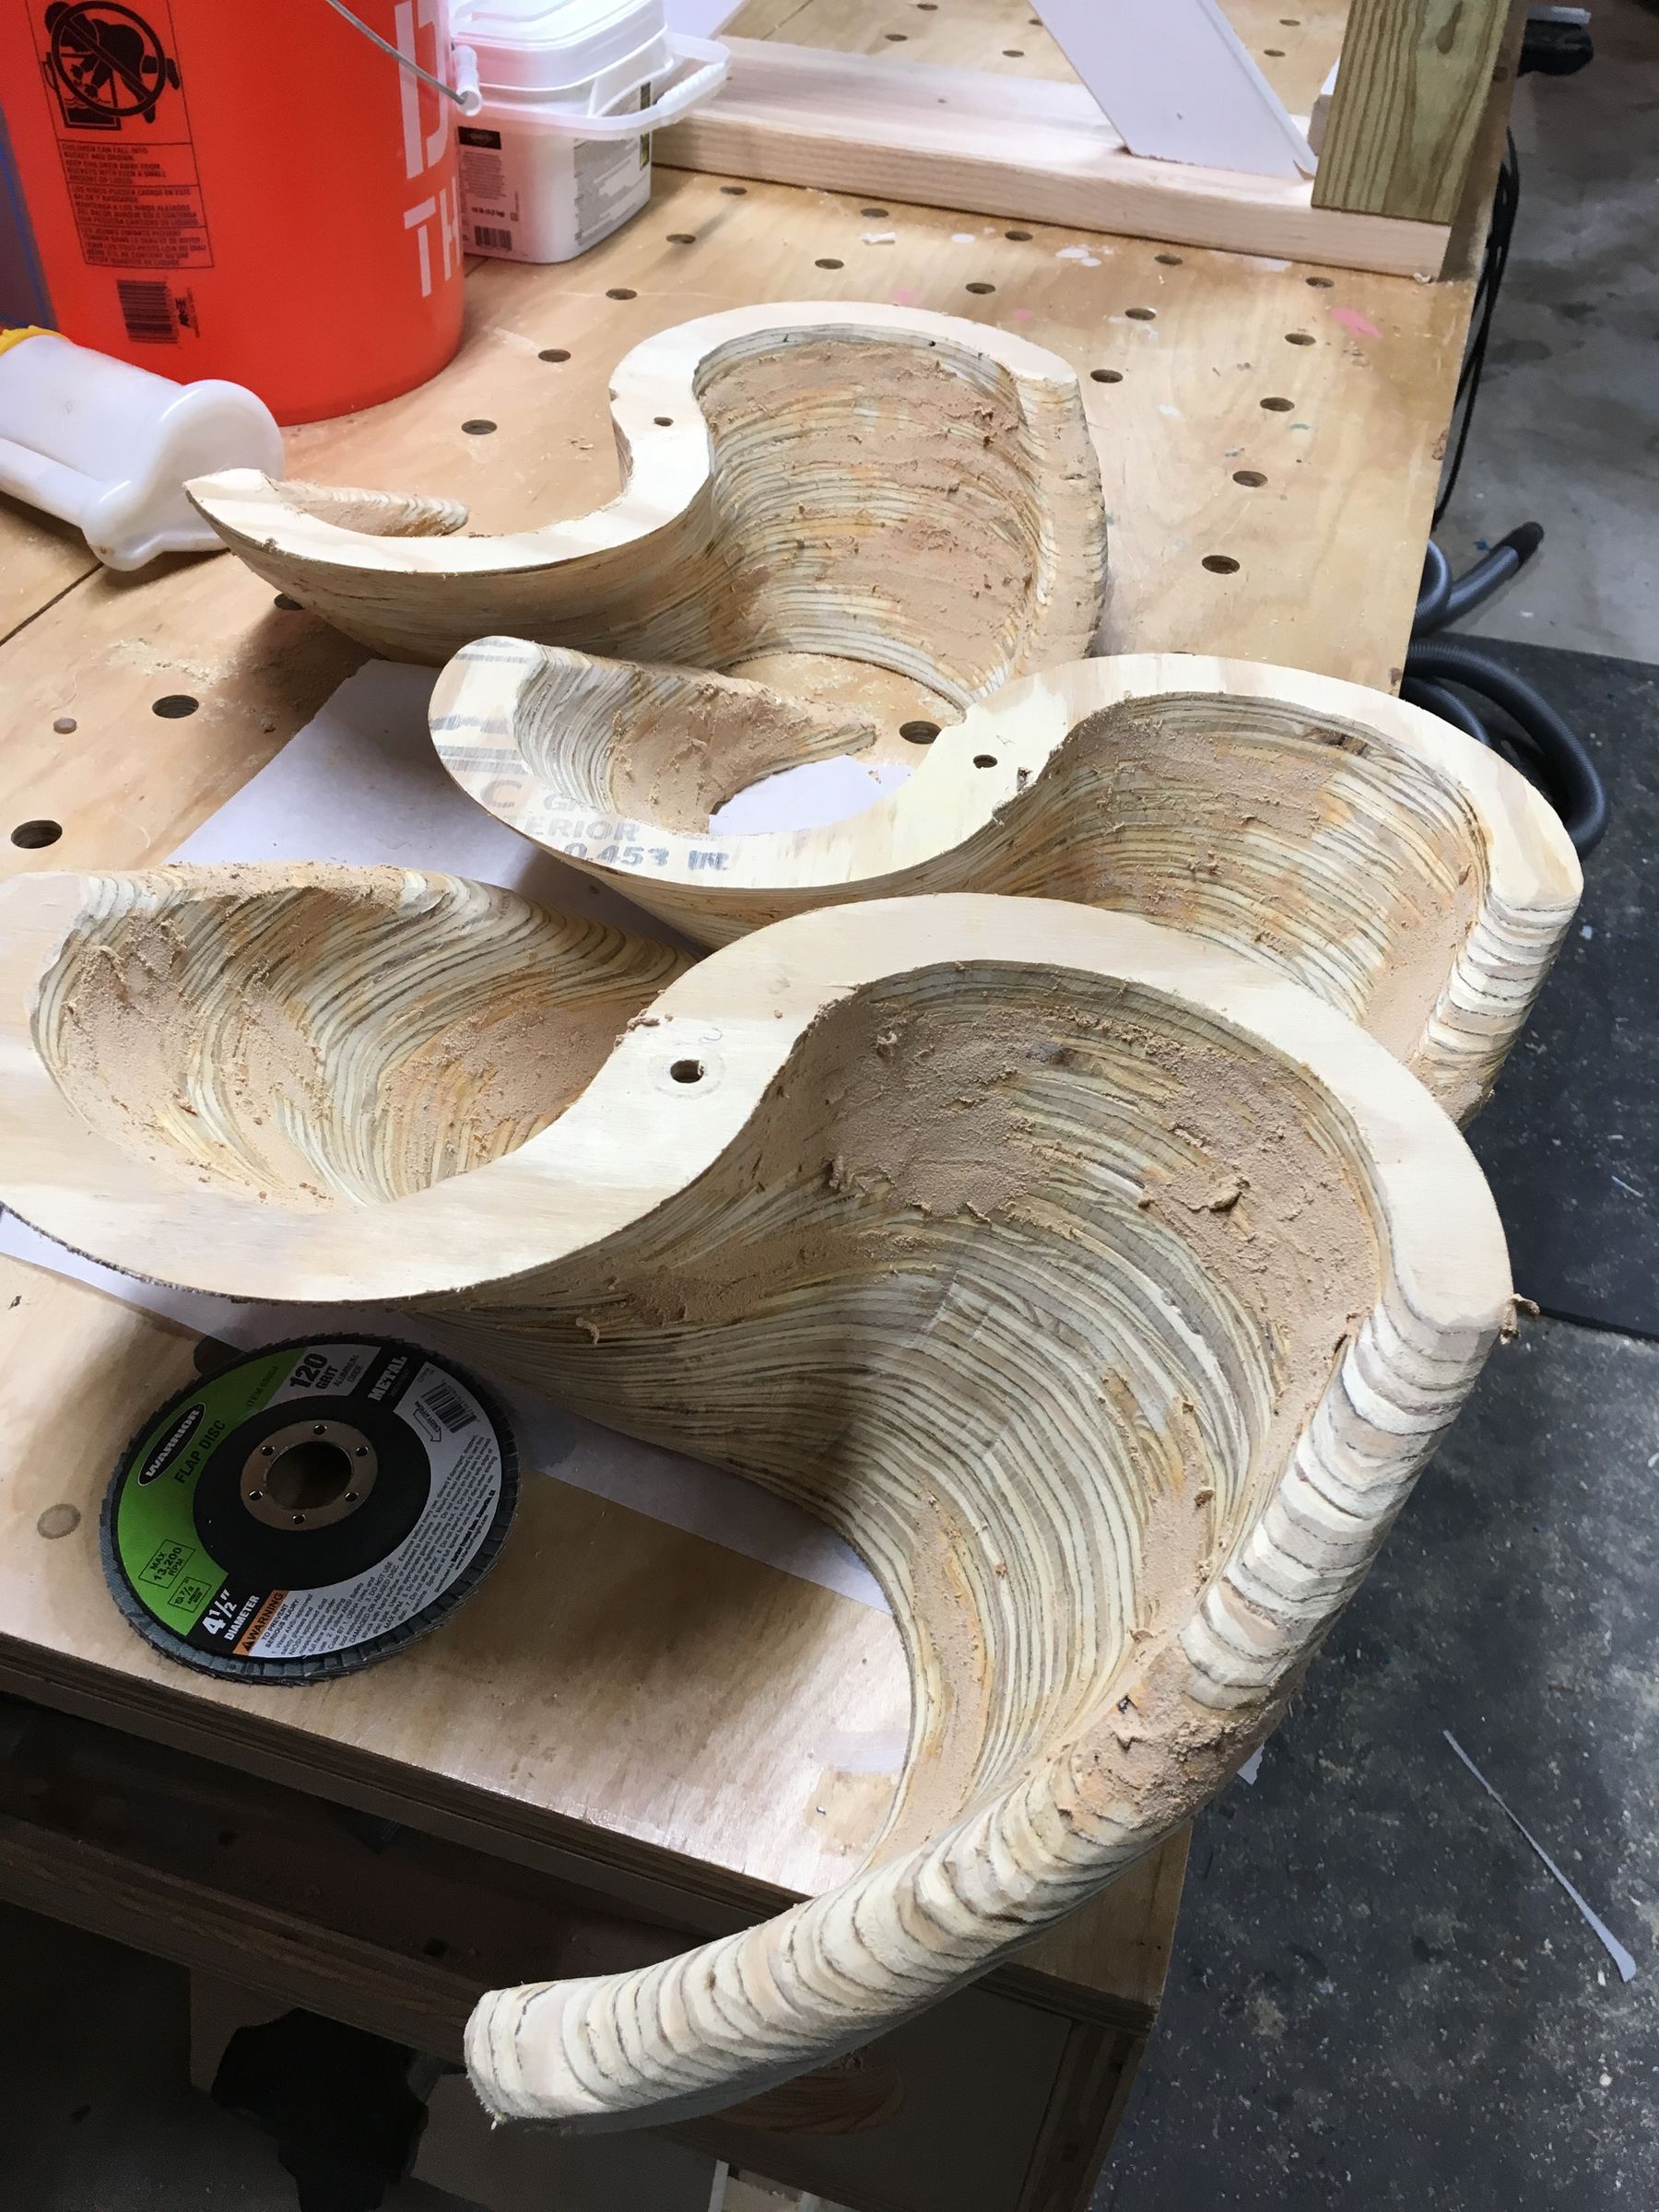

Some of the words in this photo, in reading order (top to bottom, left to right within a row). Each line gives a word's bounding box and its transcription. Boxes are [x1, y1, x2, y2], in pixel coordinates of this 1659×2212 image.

[289, 1353, 327, 1388] 120
[315, 1365, 339, 1389] GRIT
[367, 1356, 408, 1401] METAL
[145, 1408, 200, 1477] WARRIOR
[173, 1450, 202, 1484] FLAP
[198, 1419, 226, 1450] DISC
[150, 1551, 167, 1571] MAX
[153, 1547, 182, 1581] 13,200
[168, 1559, 184, 1577] RPM
[375, 1574, 385, 1585] NOT
[382, 1561, 393, 1572] USE
[224, 1595, 260, 1641] DIAMETER
[249, 1592, 284, 1645] WARNING
[262, 1631, 271, 1640] TO
[267, 1604, 288, 1630] PREVENT
[348, 1613, 369, 1642] DAMAGED
[372, 1579, 390, 1602] ABUSED
[384, 1616, 394, 1628] MAX
[265, 1619, 286, 1648] SERIOUS
